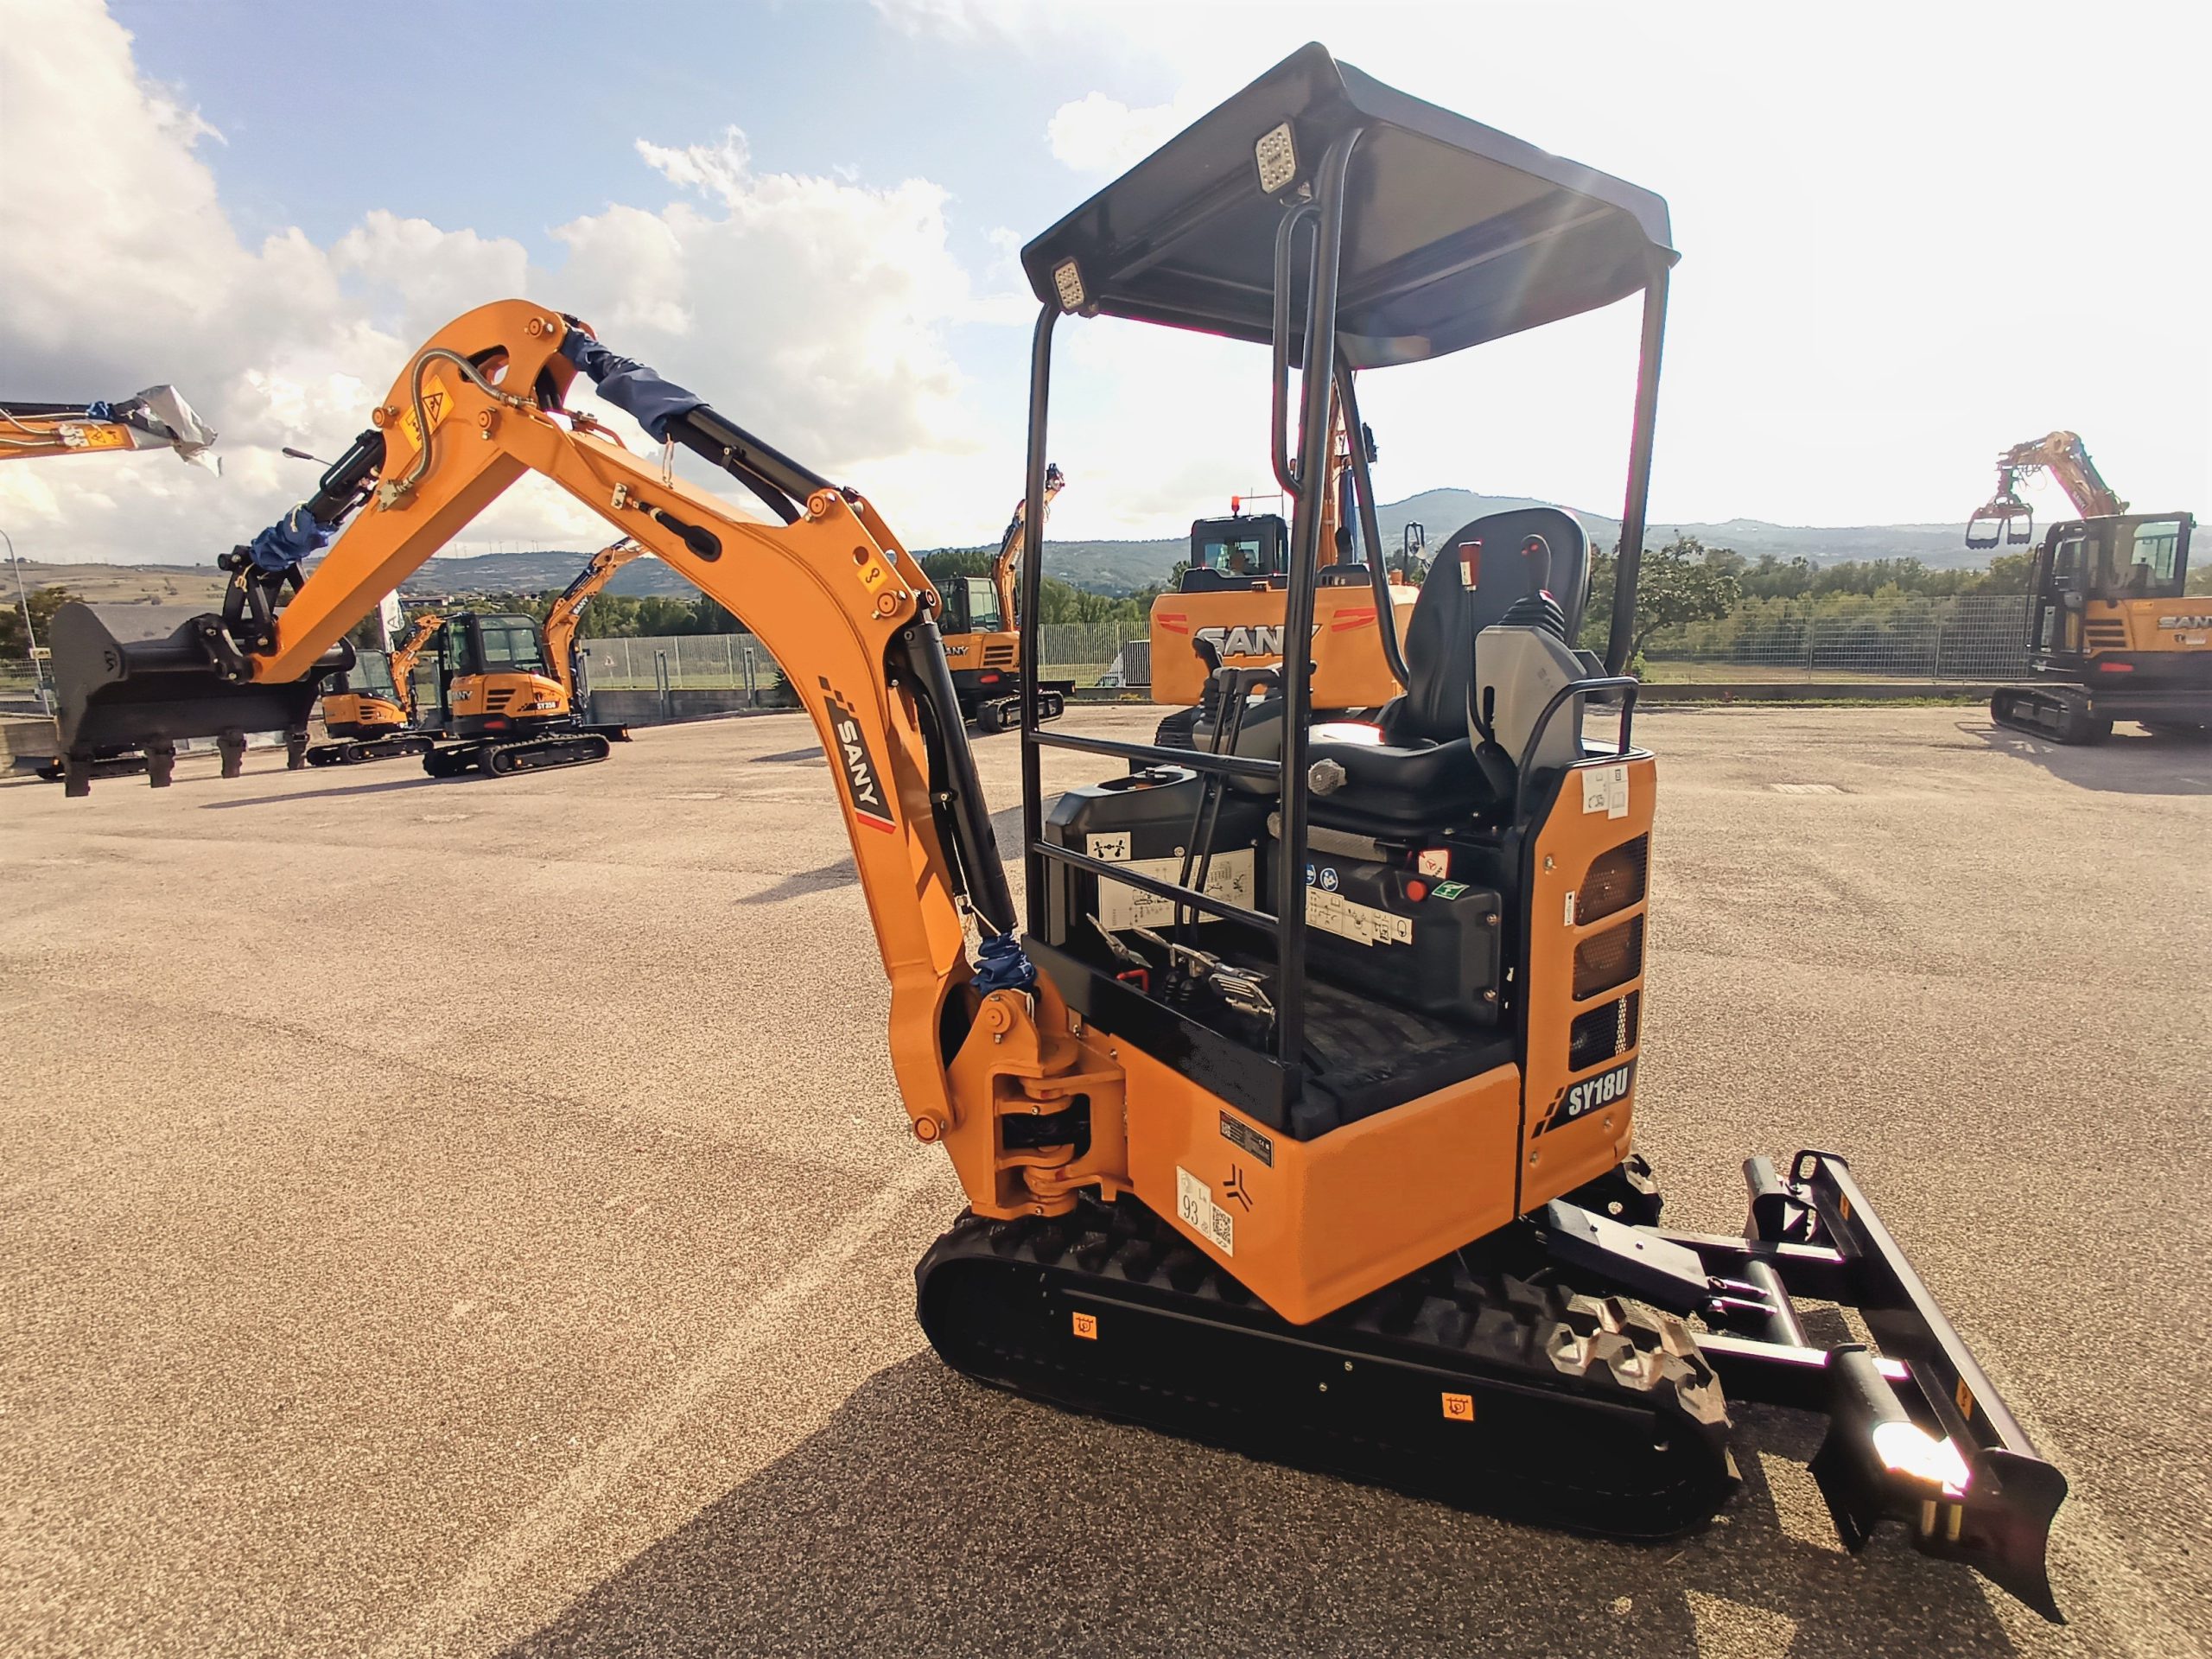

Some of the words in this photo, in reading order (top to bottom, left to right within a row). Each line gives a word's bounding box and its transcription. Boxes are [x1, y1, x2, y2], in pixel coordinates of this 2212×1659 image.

[2158, 615, 2212, 630] SAN
[837, 721, 879, 805] SANY
[1568, 1066, 1629, 1116] SY18U
[1183, 1195, 1198, 1225] 93
